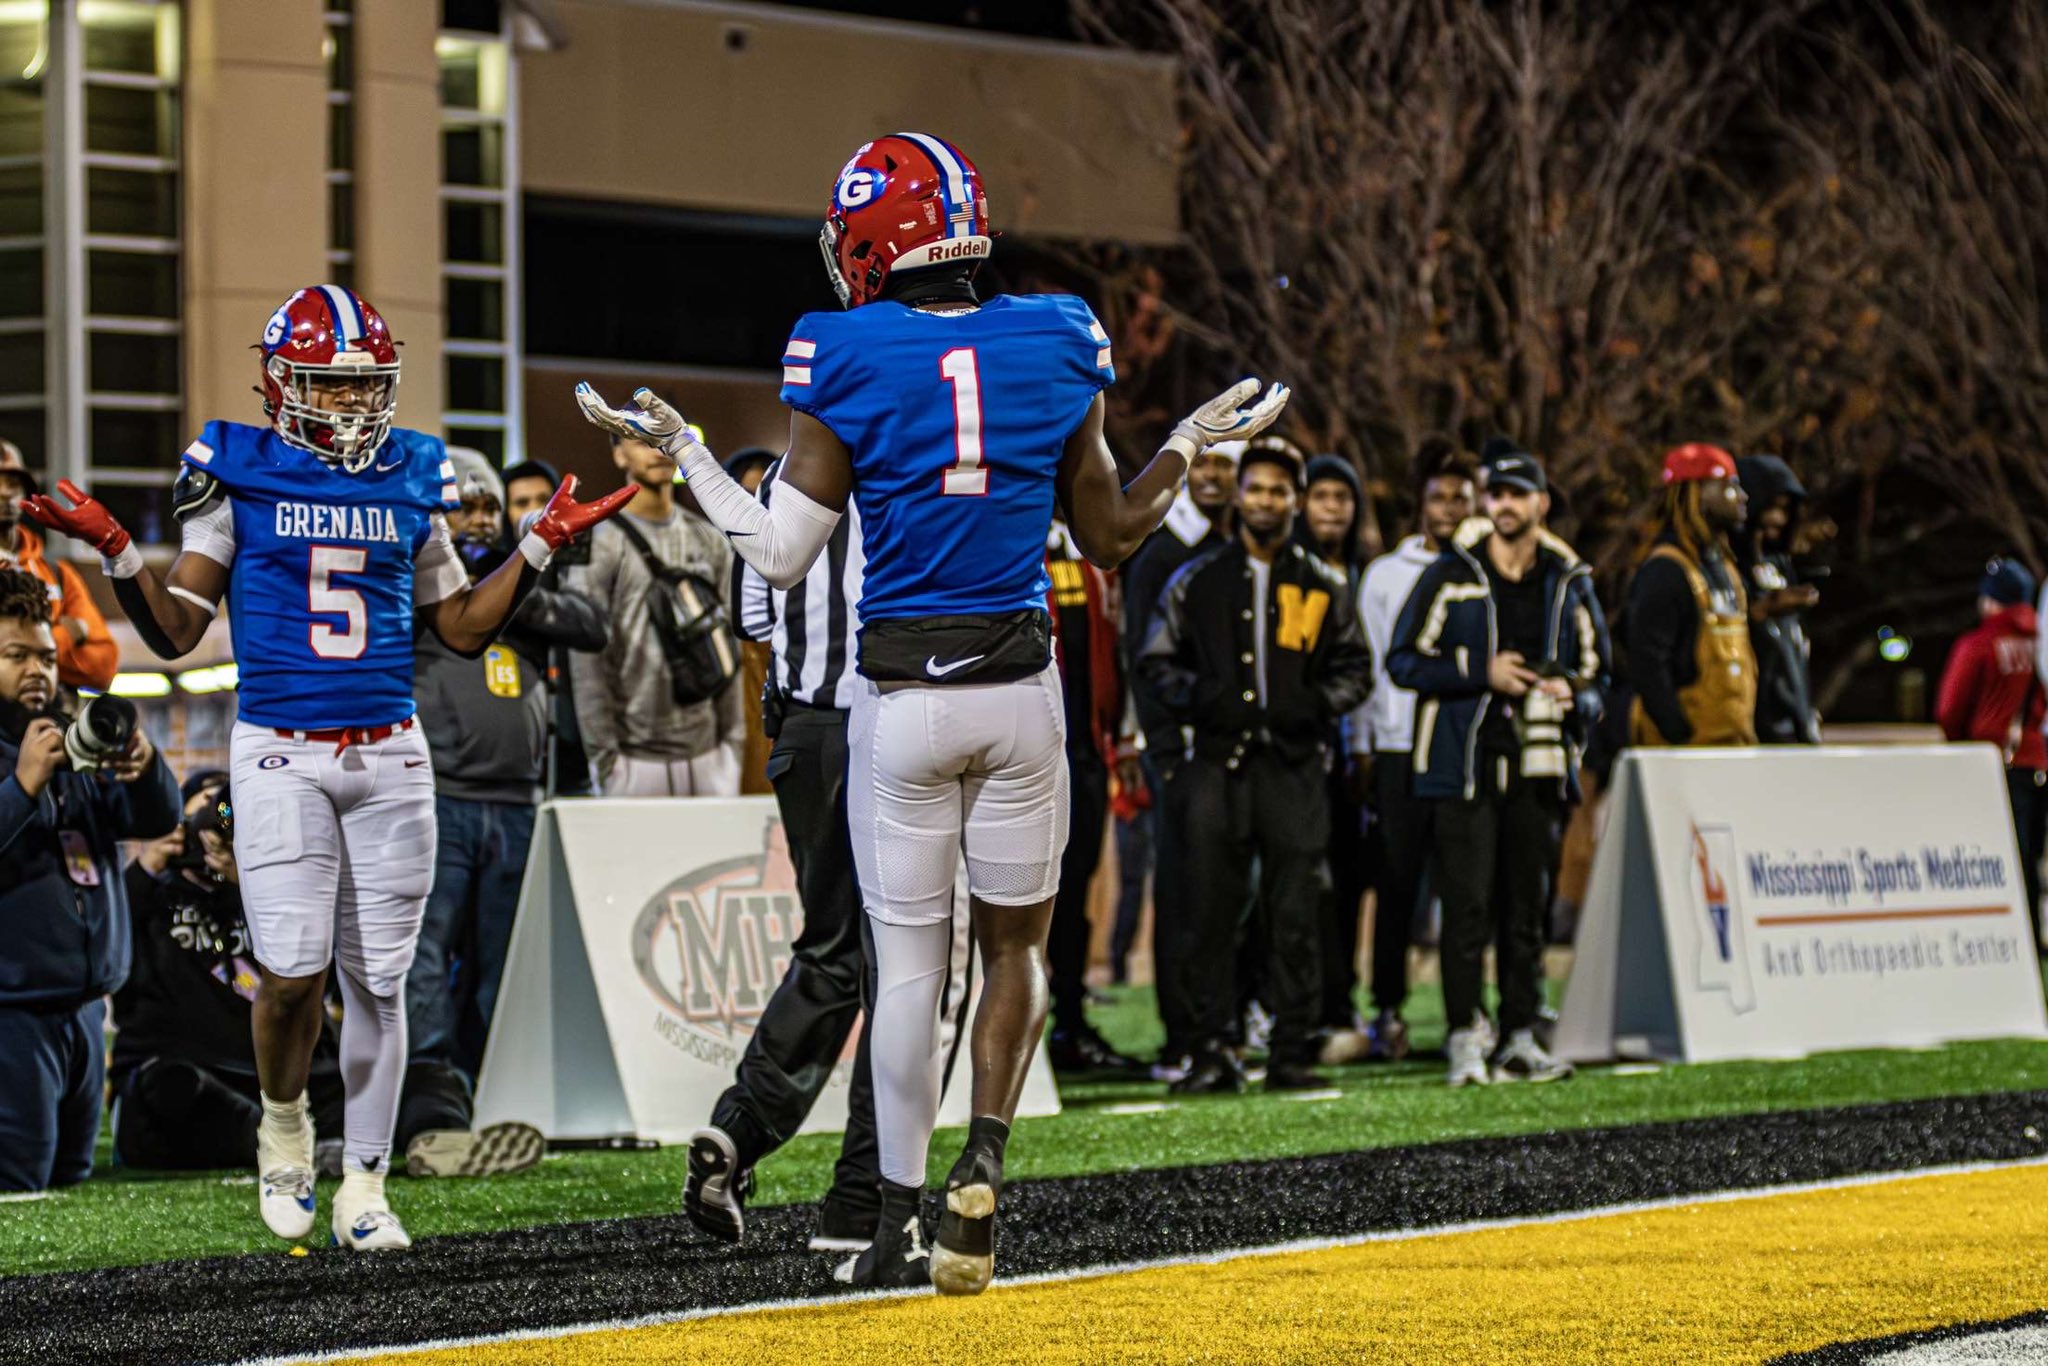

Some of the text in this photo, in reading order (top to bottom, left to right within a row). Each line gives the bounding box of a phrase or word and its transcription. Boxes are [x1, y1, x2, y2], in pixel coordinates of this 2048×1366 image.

[838, 171, 874, 208] G
[928, 240, 988, 263] Riddell
[263, 313, 287, 345] G
[938, 346, 992, 497] 1
[275, 501, 400, 543] GRENADA
[308, 544, 369, 660] 5
[1748, 845, 2006, 905] Mississippi Sports Medicine
[902, 1215, 930, 1263] 1
